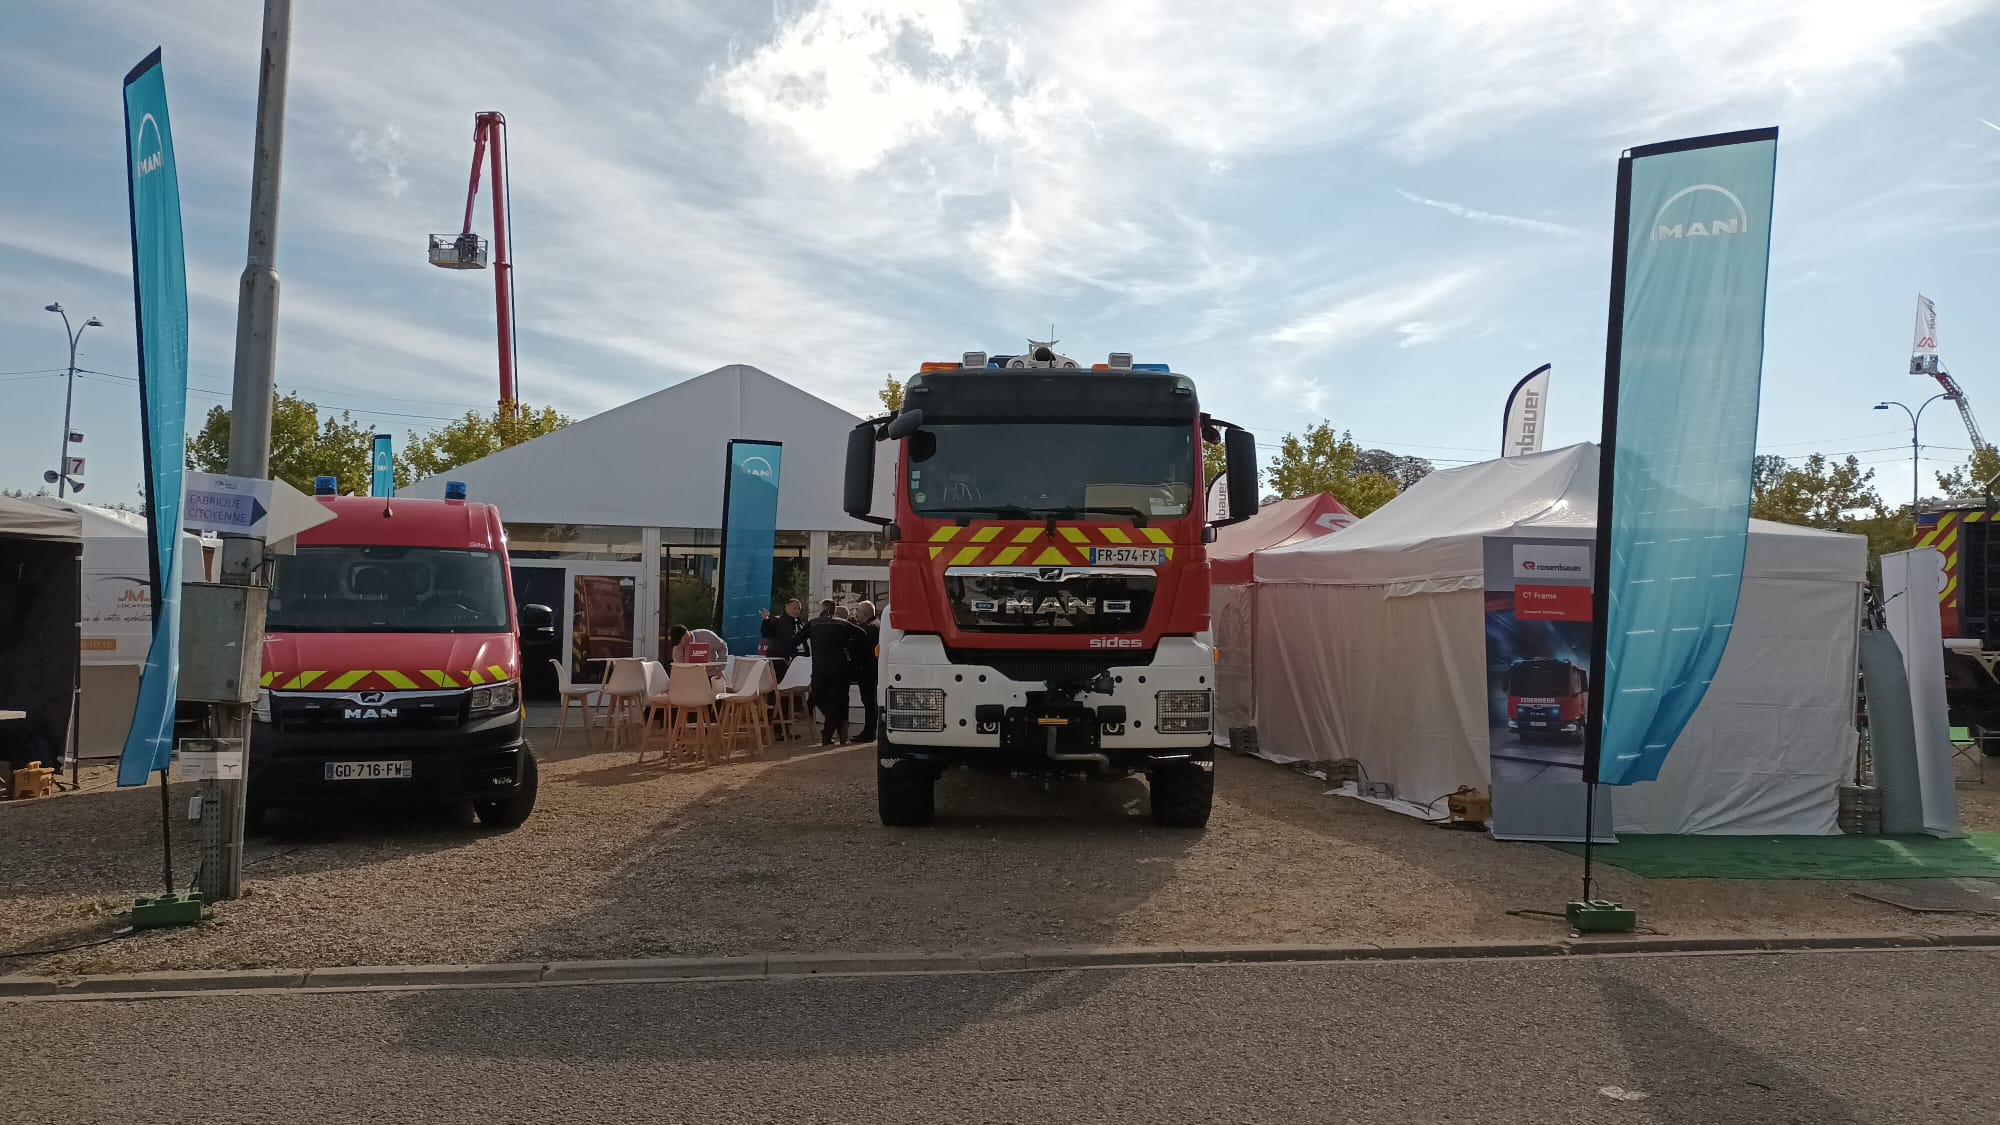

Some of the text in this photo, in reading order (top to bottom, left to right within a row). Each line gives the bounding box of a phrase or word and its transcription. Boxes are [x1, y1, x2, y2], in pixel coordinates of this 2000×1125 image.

[140, 151, 162, 175] MAN
[1658, 218, 1738, 241] MAN
[72, 459, 83, 474] 7
[190, 494, 241, 509] FABRIQUE
[1215, 481, 1227, 520] bauer
[187, 507, 248, 523] CITOYENNE
[1097, 549, 1157, 562] FR-574-FX
[1537, 563, 1582, 572] rosenbauer
[1522, 591, 1558, 600] CT Frame
[1005, 596, 1097, 615] MAN
[1089, 636, 1143, 648] sides
[344, 708, 398, 719] MAN
[335, 763, 402, 778] GD-716-FW
